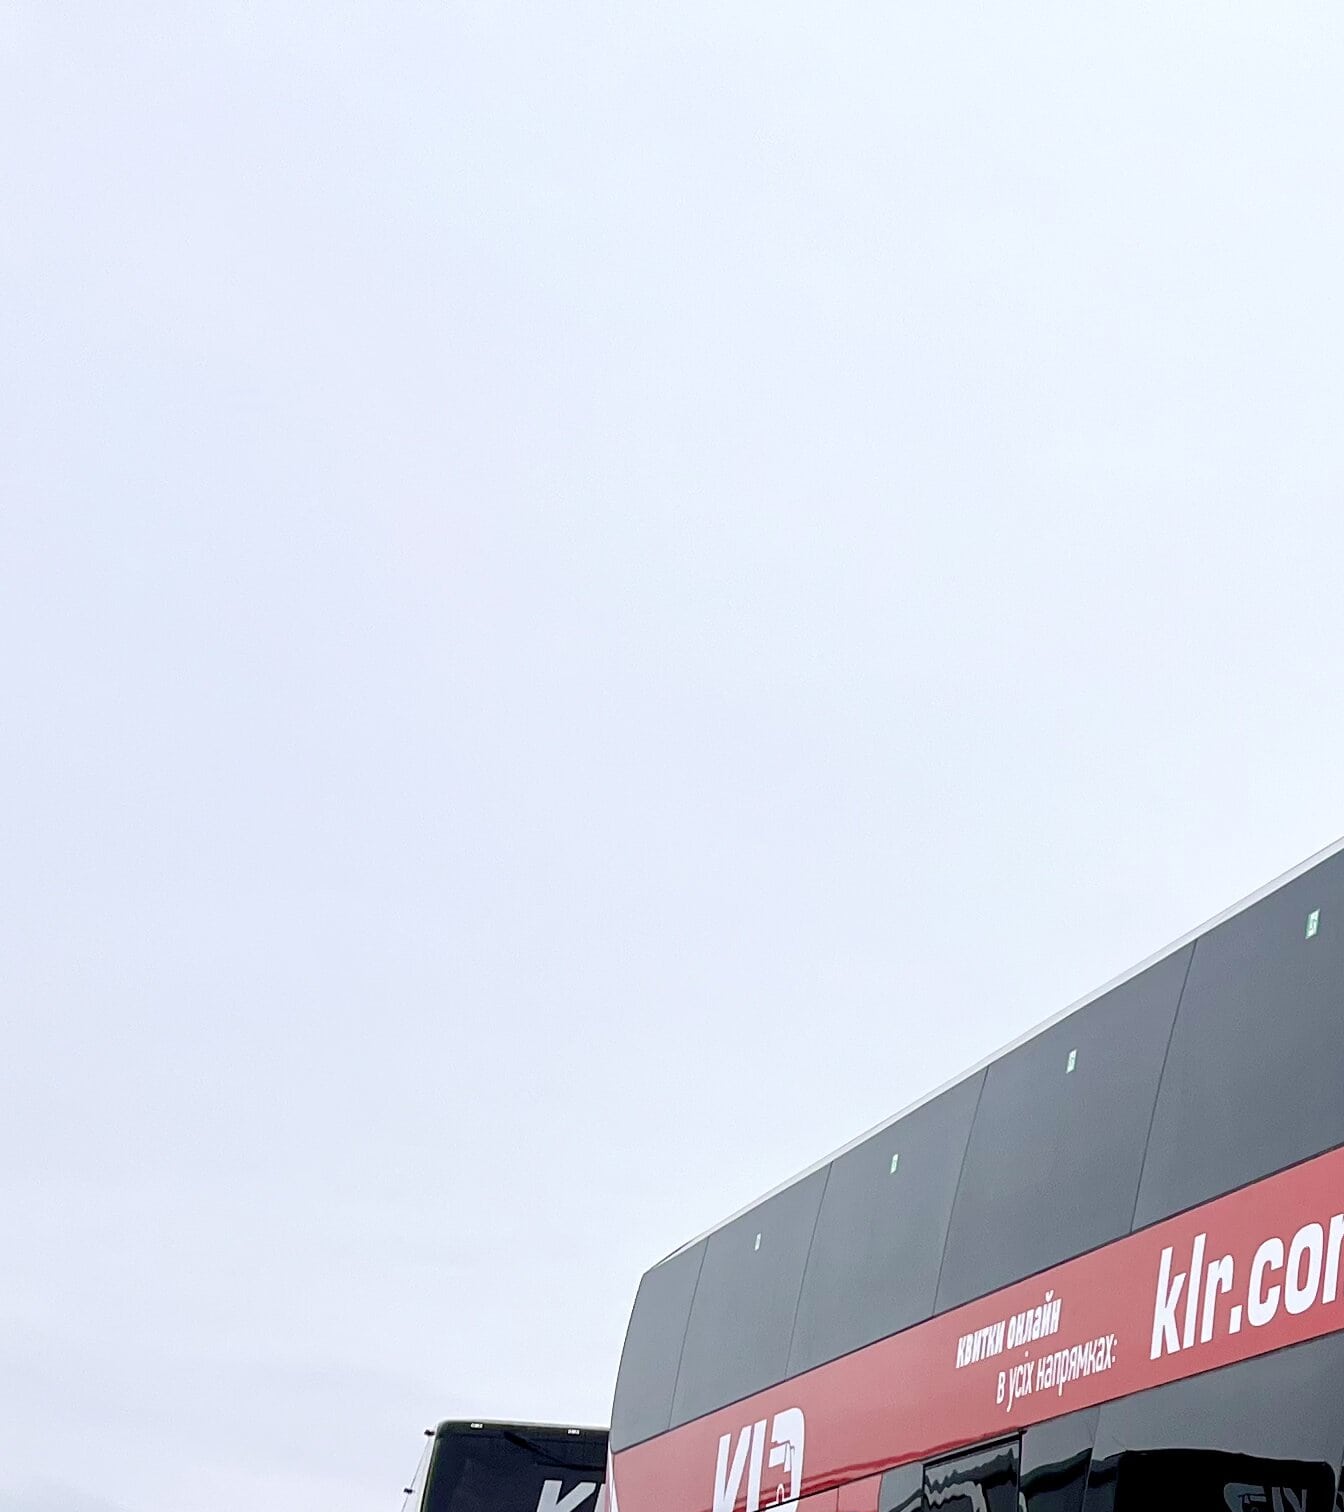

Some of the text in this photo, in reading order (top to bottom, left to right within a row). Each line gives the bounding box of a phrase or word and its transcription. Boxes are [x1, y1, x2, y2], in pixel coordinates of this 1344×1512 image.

[956, 1289, 1062, 1369] квитки онлайн
[996, 1333, 1118, 1413] в усіх напрямках:
